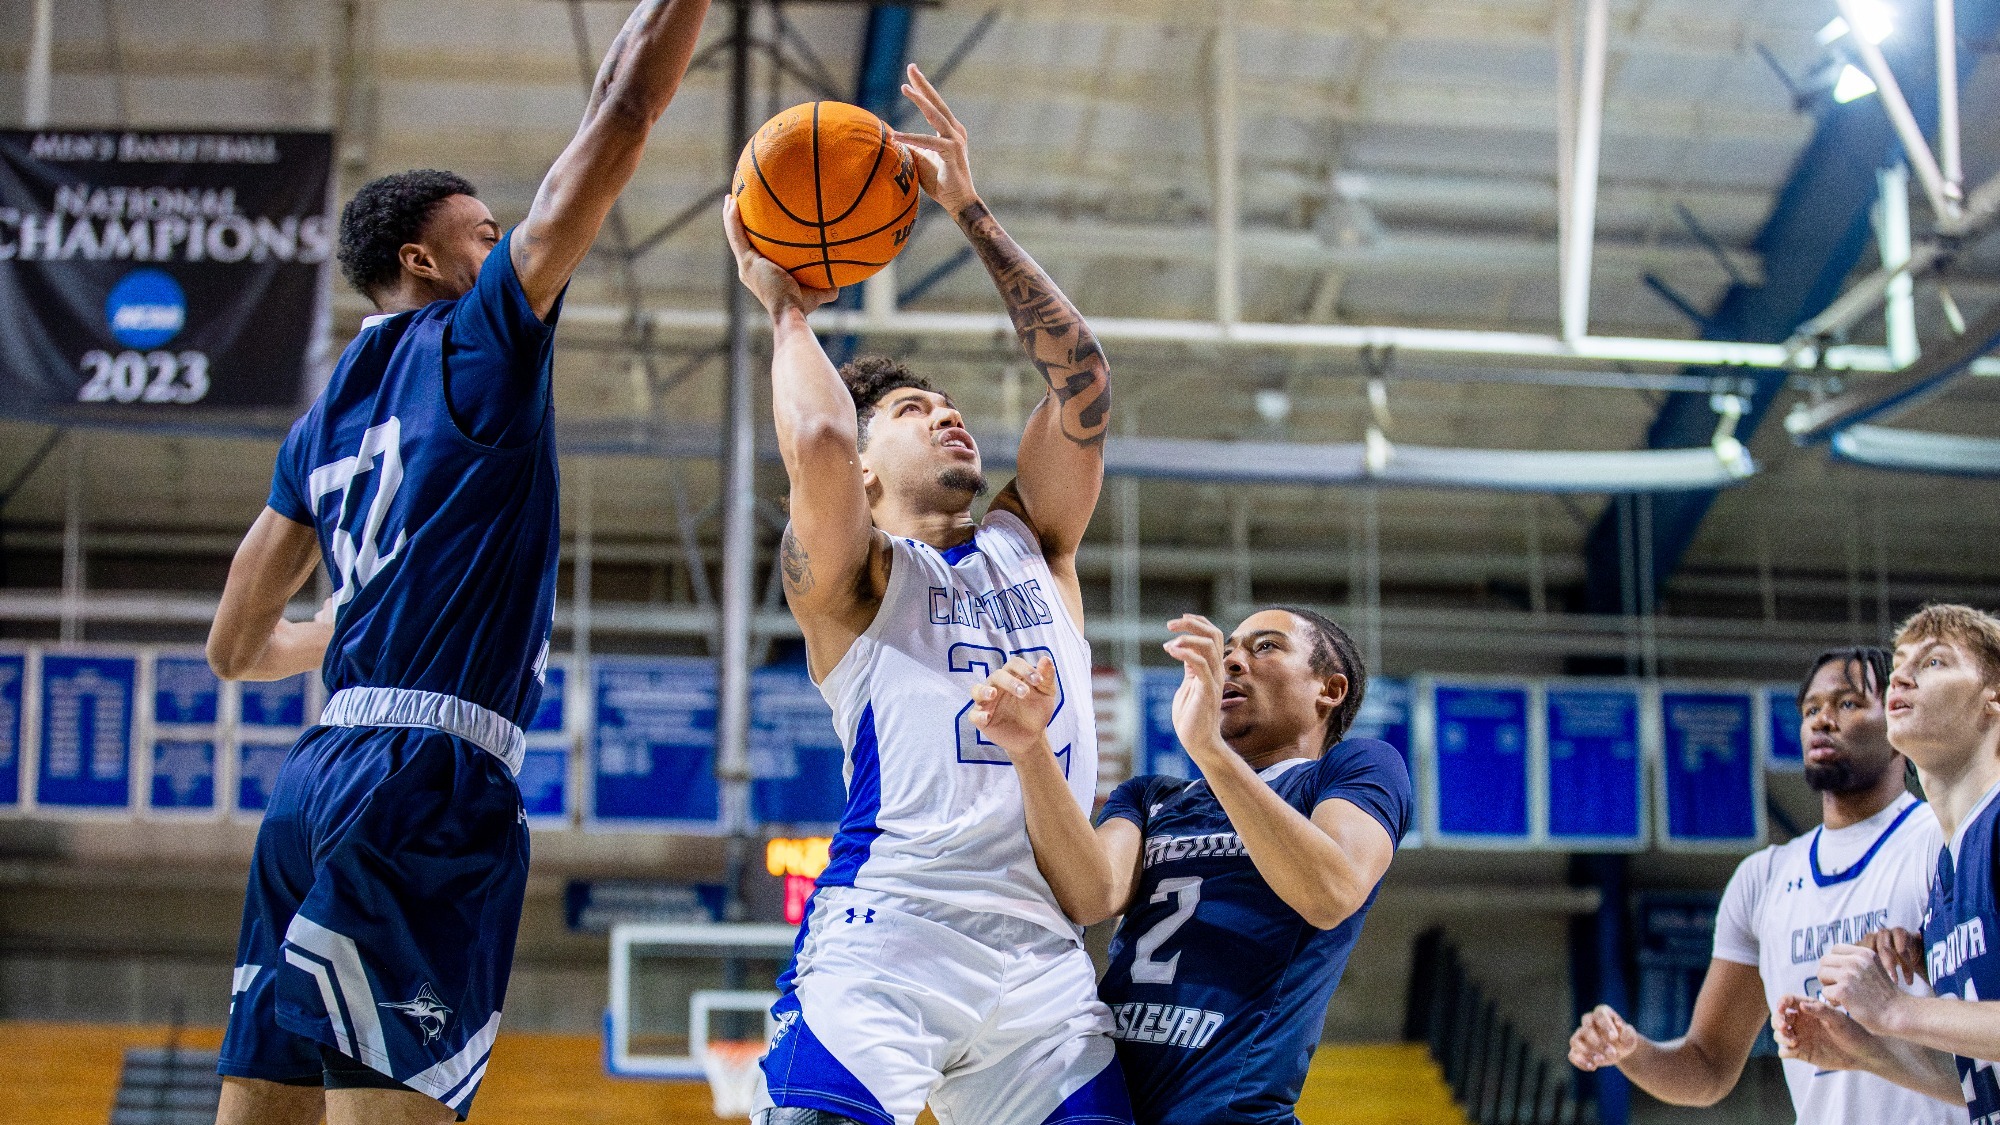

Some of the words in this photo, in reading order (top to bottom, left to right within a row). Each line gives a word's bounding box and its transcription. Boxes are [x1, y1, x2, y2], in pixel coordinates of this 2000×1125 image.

[55, 184, 237, 218] NATIONAL
[79, 350, 210, 403] 2023
[928, 578, 1054, 634] CAPTINS
[1131, 876, 1204, 984] 2
